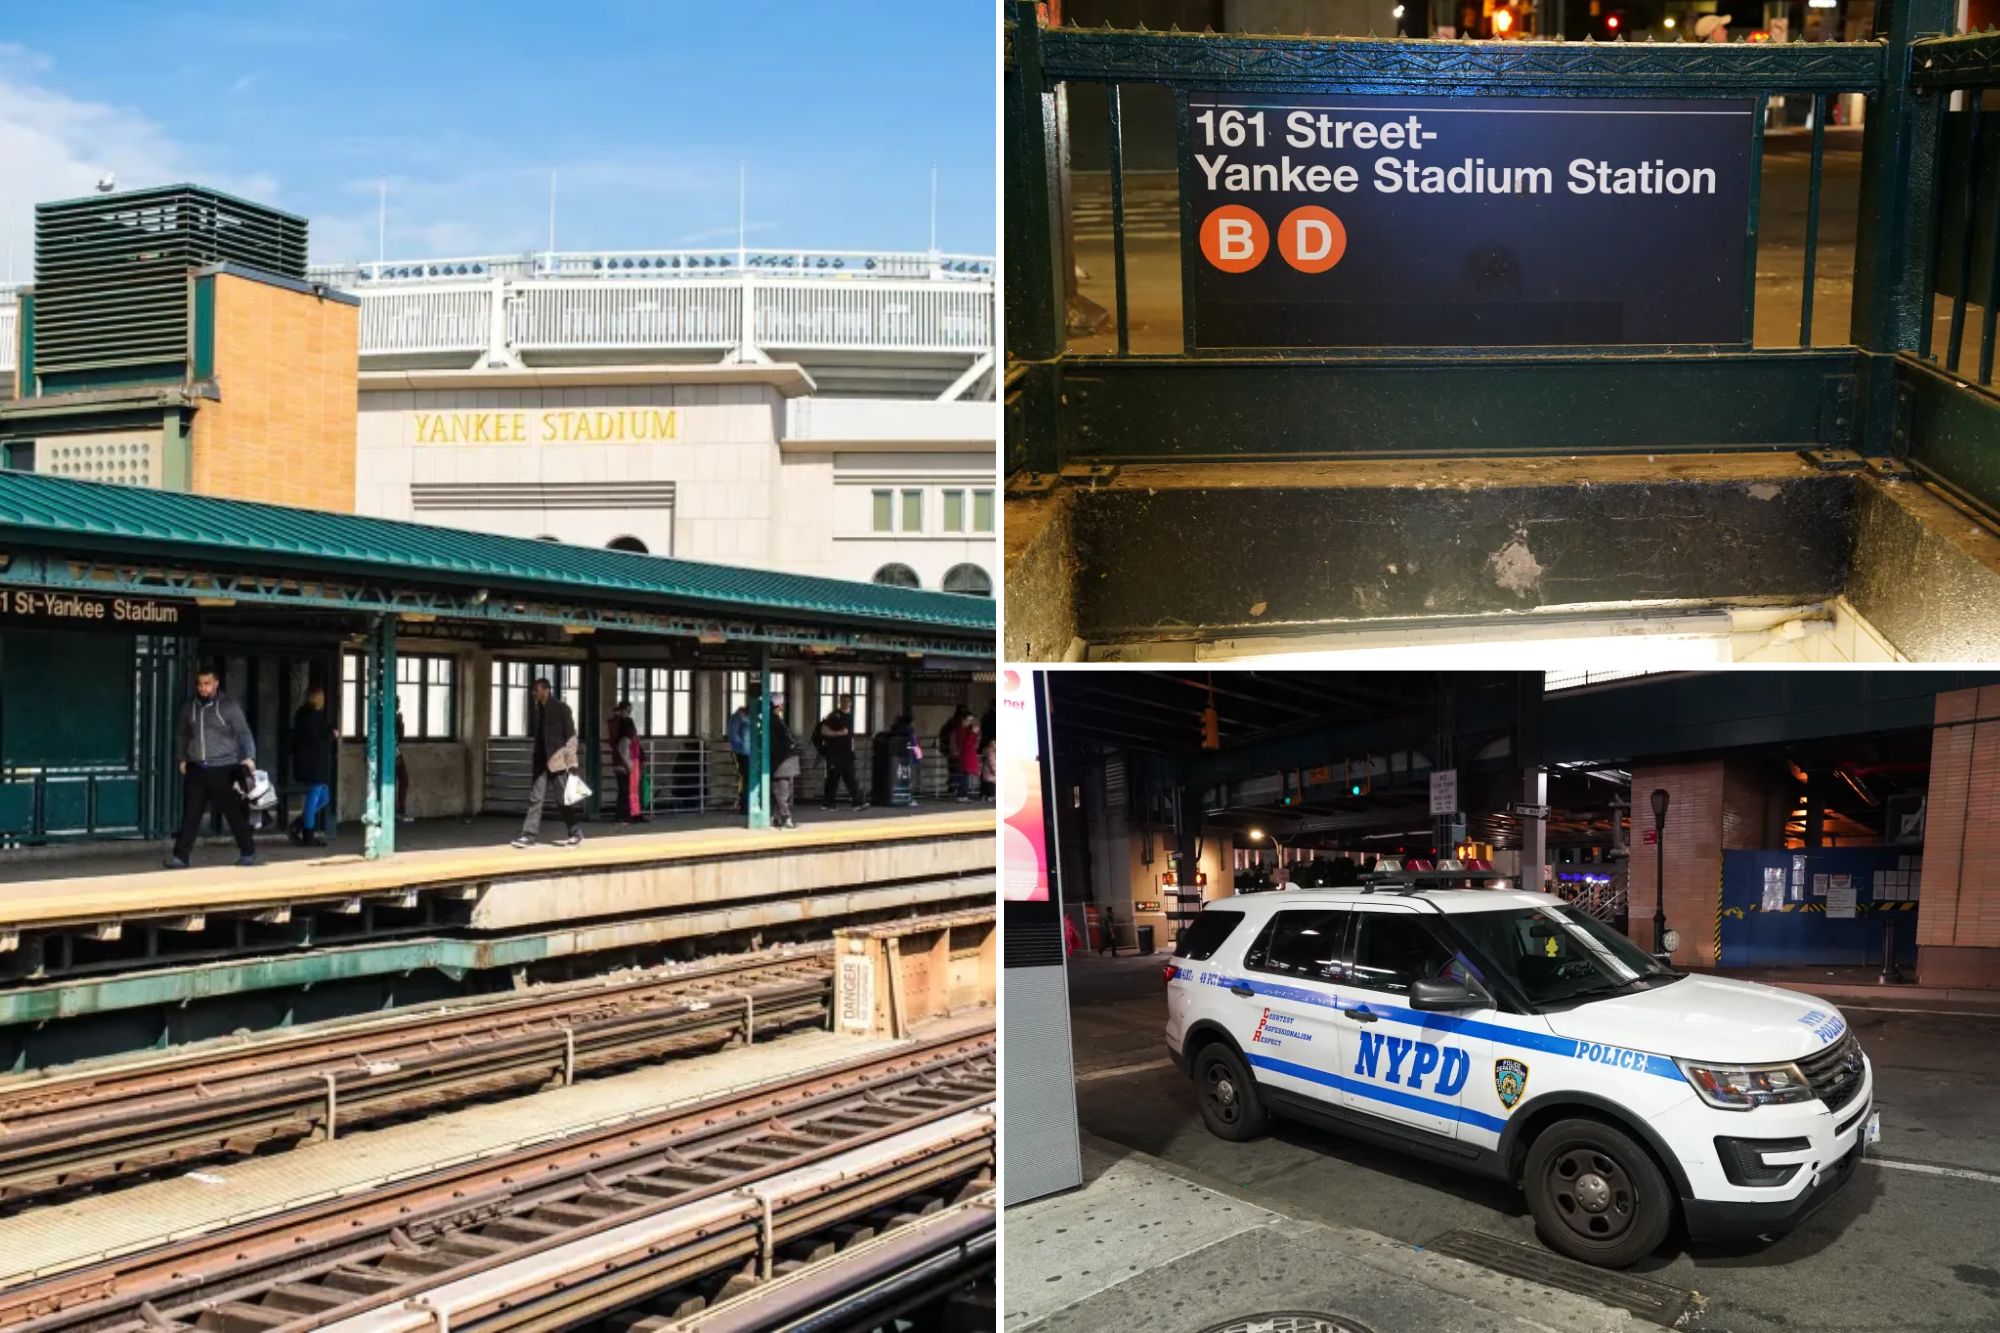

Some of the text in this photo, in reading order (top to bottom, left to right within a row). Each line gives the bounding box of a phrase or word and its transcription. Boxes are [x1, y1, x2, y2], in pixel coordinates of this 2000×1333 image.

[1196, 111, 1438, 150] 161 Street-
[1195, 155, 1716, 195] Yankee Stadium Station
[1218, 218, 1255, 260] B
[1296, 219, 1333, 260] D
[415, 409, 678, 444] YANKEE STADIUM
[113, 599, 178, 623] Stadium
[844, 963, 855, 1019] DANGER
[1258, 1019, 1312, 1041] PROFESSIONALISM
[1263, 1007, 1295, 1025] COURTESY
[1252, 1030, 1282, 1047] RESPECT
[1575, 1040, 1648, 1072] POLICE
[1354, 1030, 1470, 1096] NYPD
